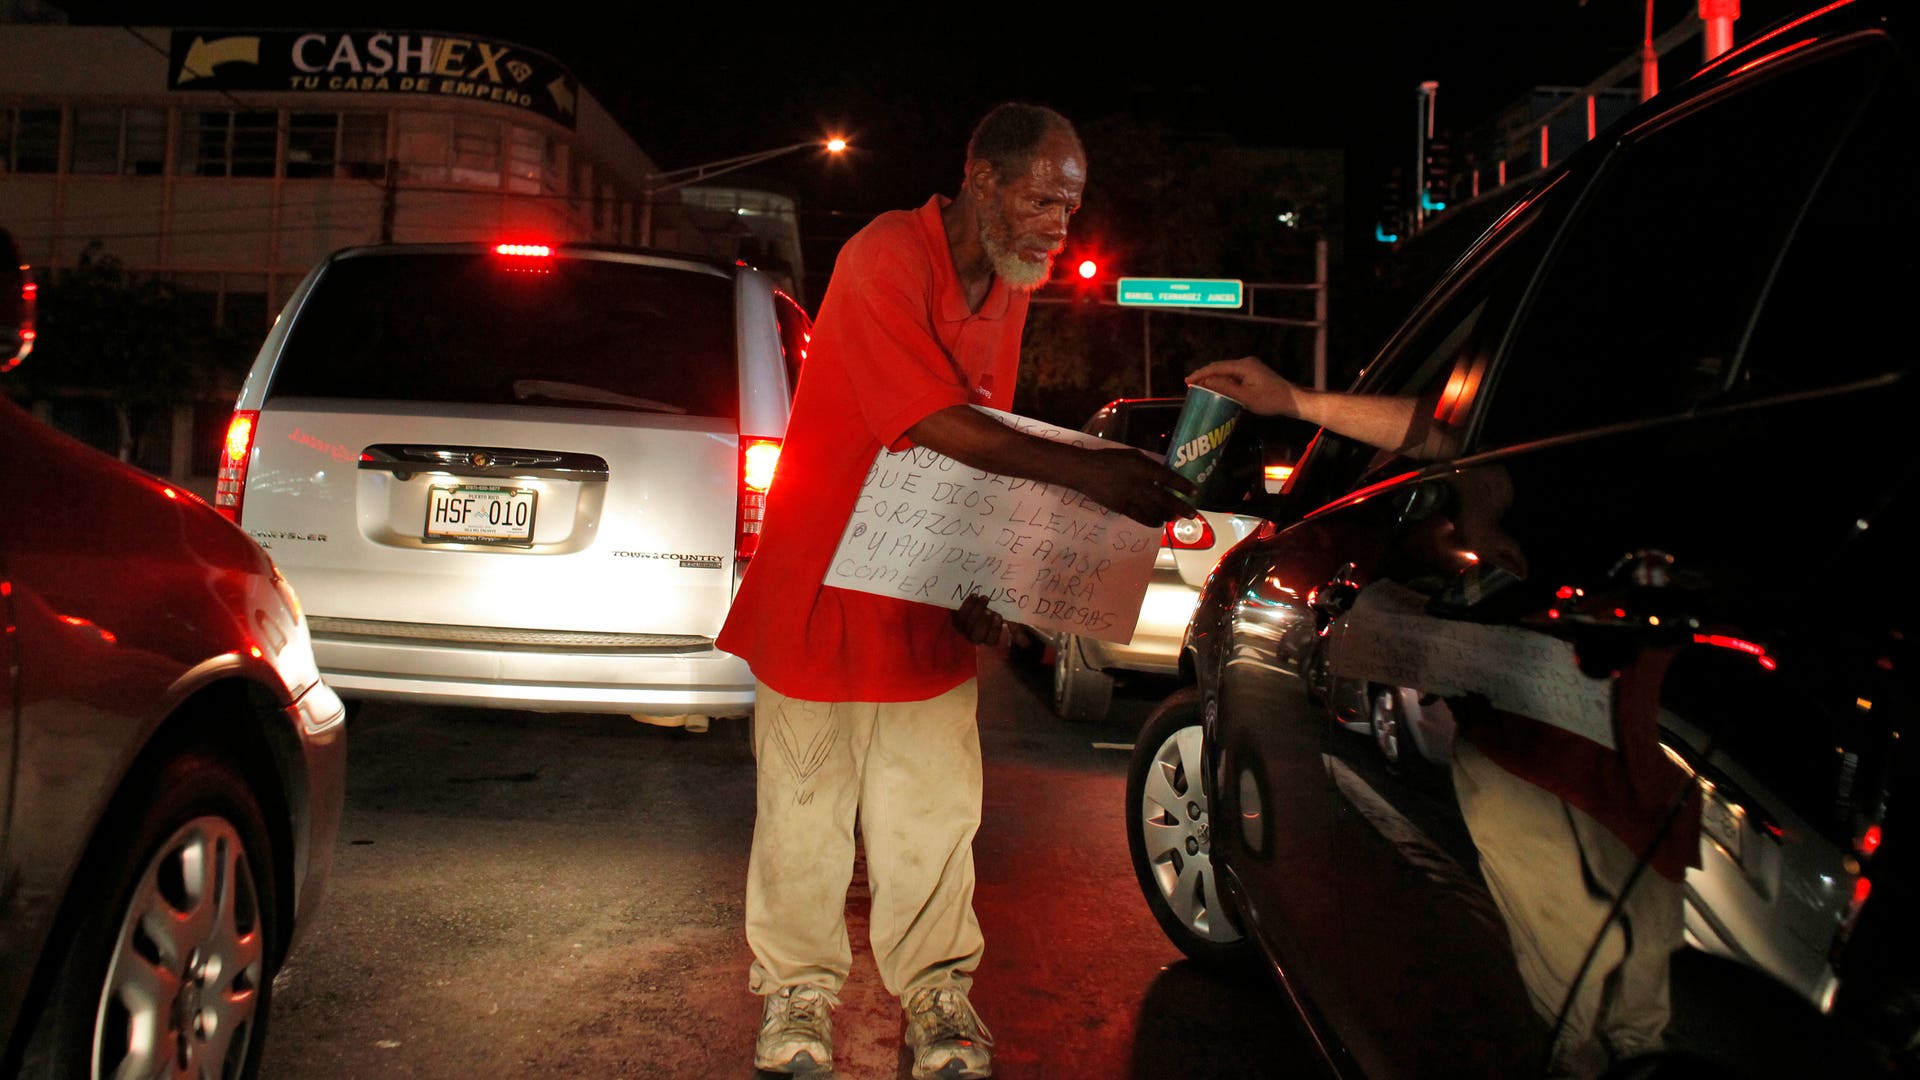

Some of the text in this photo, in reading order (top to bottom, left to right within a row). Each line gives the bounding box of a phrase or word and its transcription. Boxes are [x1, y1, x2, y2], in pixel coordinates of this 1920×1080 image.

[291, 76, 532, 107] TU CASA DE EMPEÑO
[435, 497, 528, 526] HSF 010
[931, 481, 997, 516] DIOS
[1008, 500, 1107, 544] LLENE
[1112, 530, 1151, 553] SU
[853, 495, 1112, 583] CORAZON DE AMOR
[835, 558, 939, 597] COMER
[989, 587, 1030, 610] USO
[1030, 568, 1095, 602] PARA
